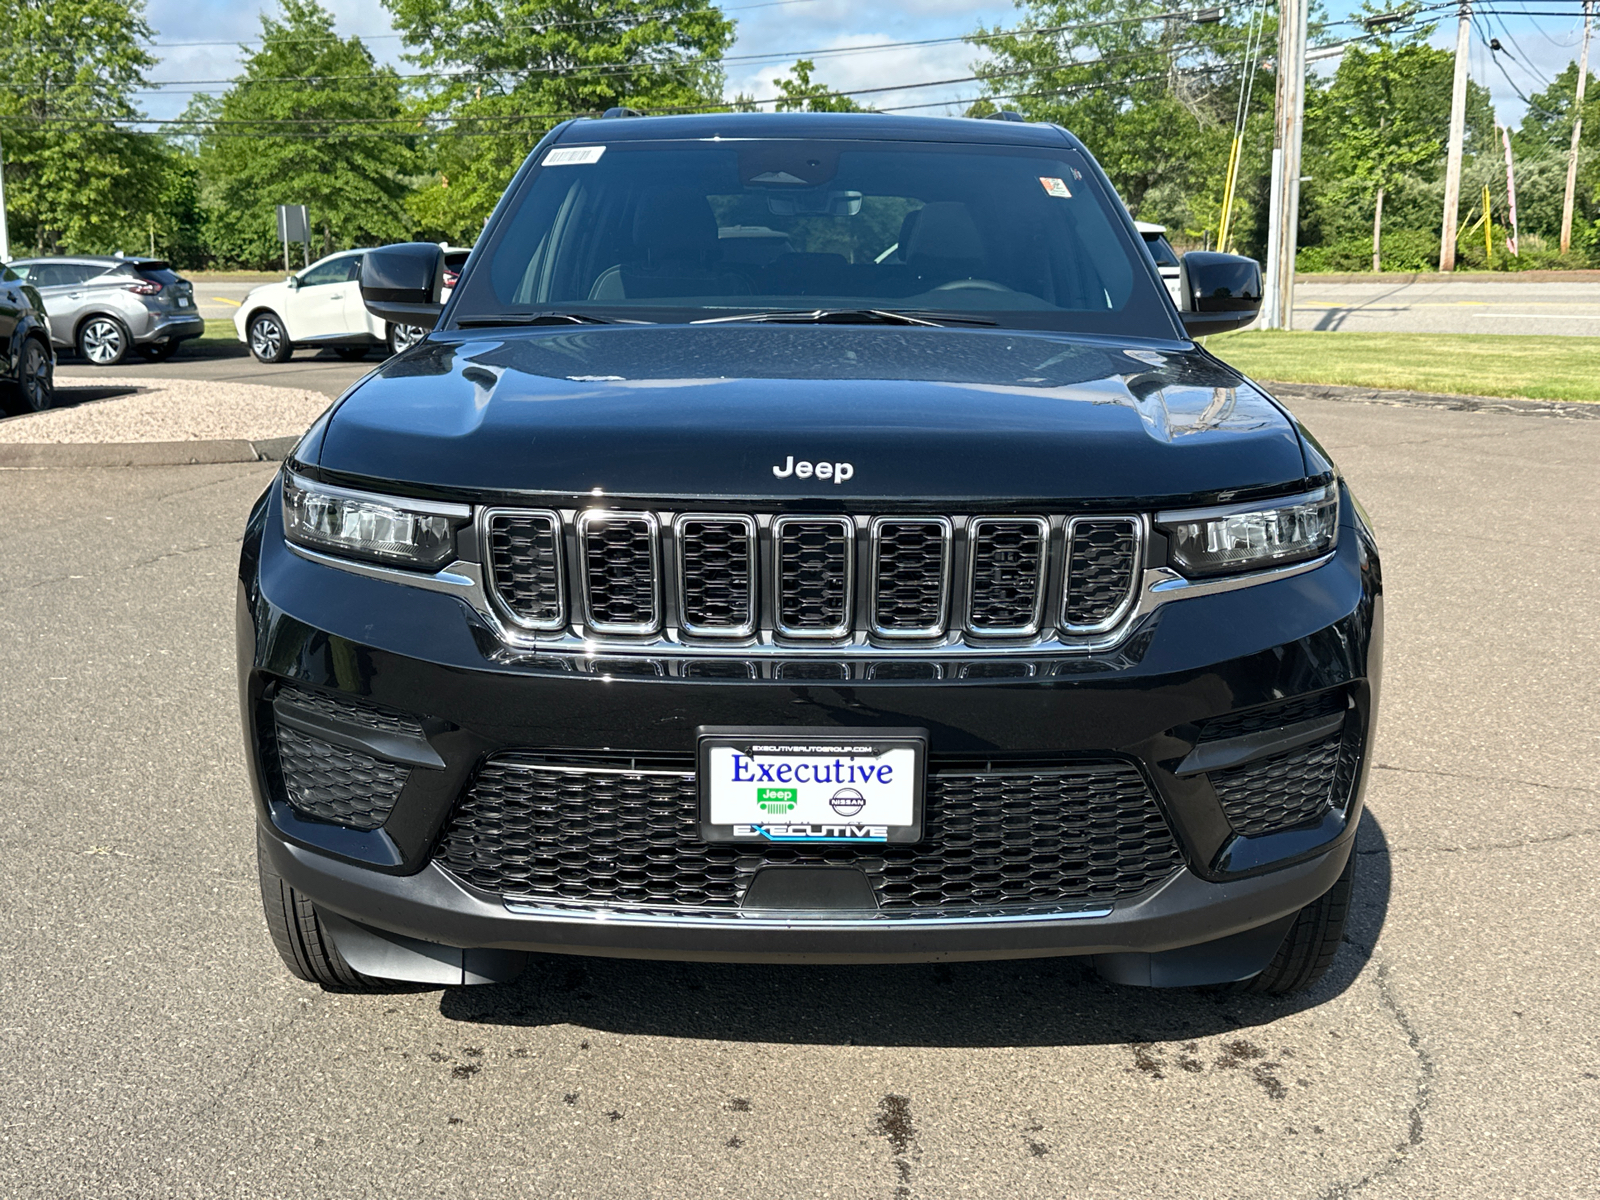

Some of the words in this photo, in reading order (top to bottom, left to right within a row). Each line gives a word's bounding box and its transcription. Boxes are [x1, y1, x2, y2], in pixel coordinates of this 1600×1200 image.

[773, 456, 854, 484] Jeep
[752, 745, 872, 753] EXECUTIVEAUTOGROUP.COM
[731, 754, 893, 784] Executive
[762, 789, 792, 801] Jeep
[733, 825, 888, 838] EXECUTIVE
